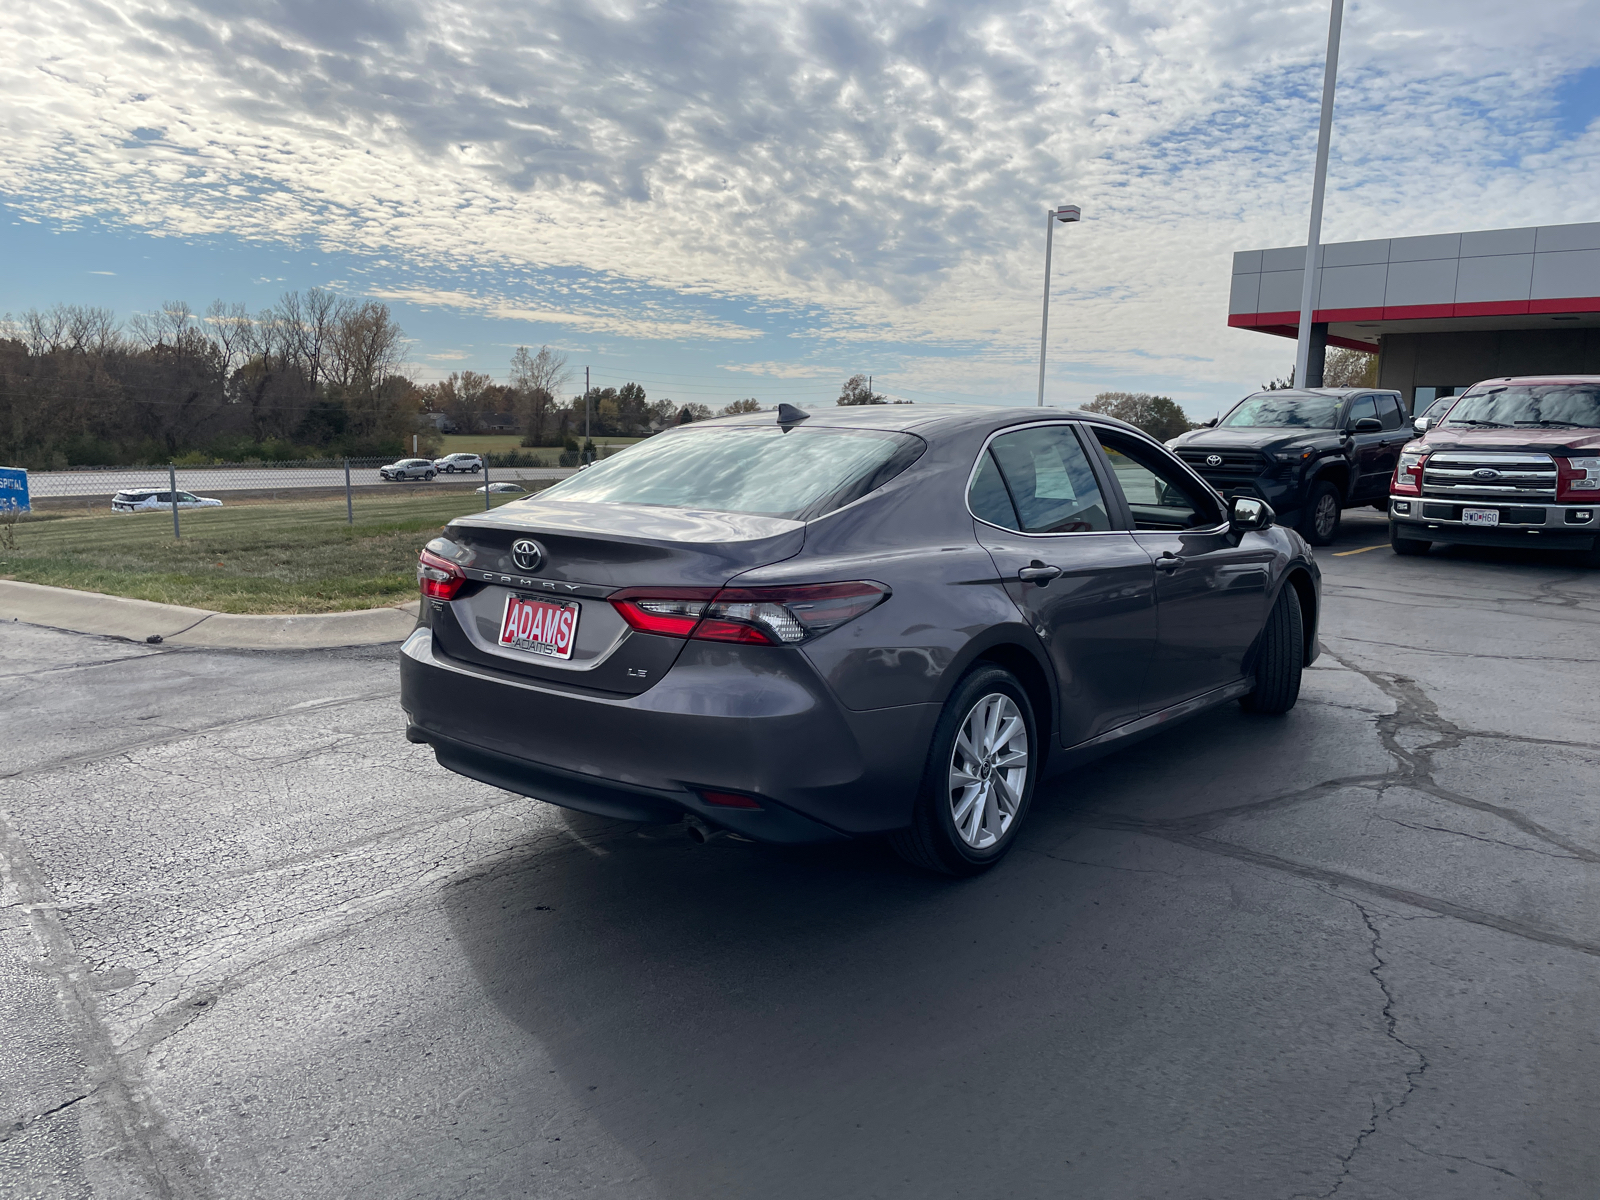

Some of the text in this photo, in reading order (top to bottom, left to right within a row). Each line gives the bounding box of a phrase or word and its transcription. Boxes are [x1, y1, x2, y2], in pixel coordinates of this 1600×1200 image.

[483, 573, 580, 591] CAMRY
[504, 603, 572, 648] ADAMS
[514, 638, 554, 655] ADAMS
[627, 668, 648, 678] LE
